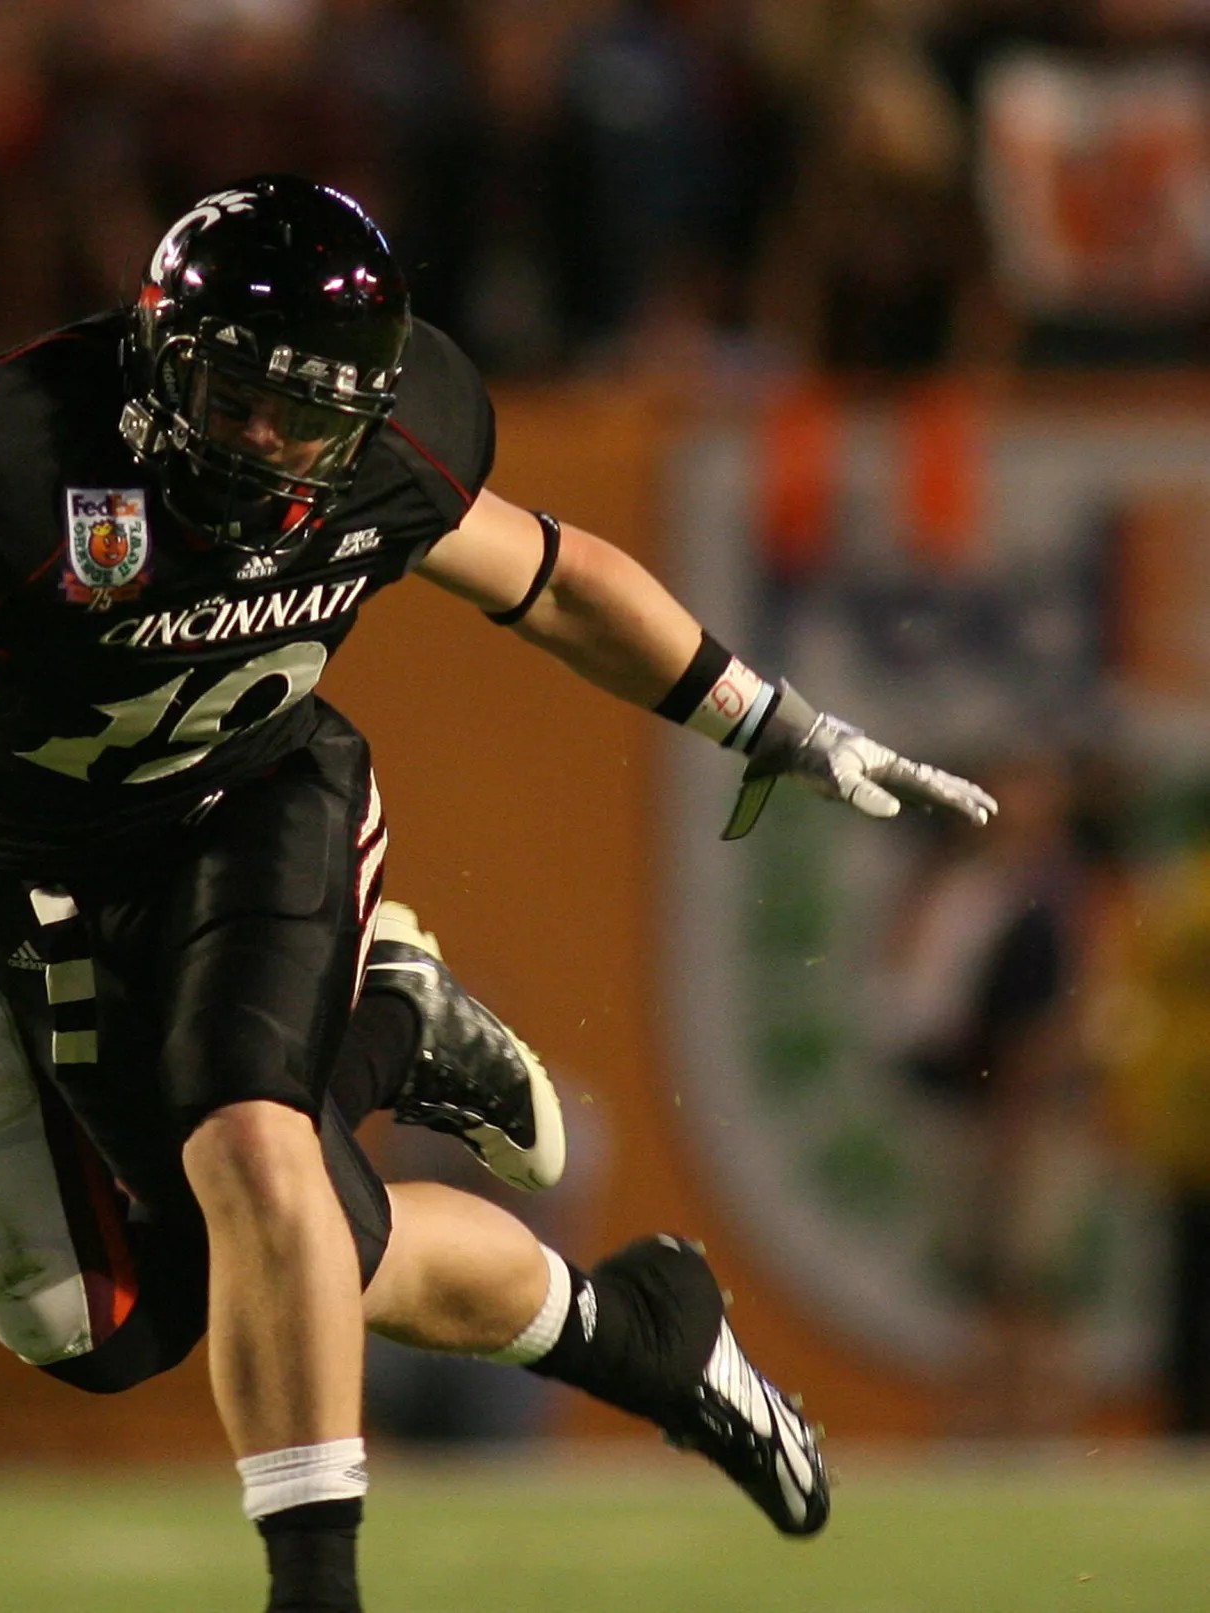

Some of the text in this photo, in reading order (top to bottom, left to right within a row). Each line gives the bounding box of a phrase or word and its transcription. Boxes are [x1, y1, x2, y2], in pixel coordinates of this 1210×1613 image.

[71, 493, 141, 517] FedEx
[236, 565, 278, 580] adidas
[100, 576, 368, 647] CINCINNATI
